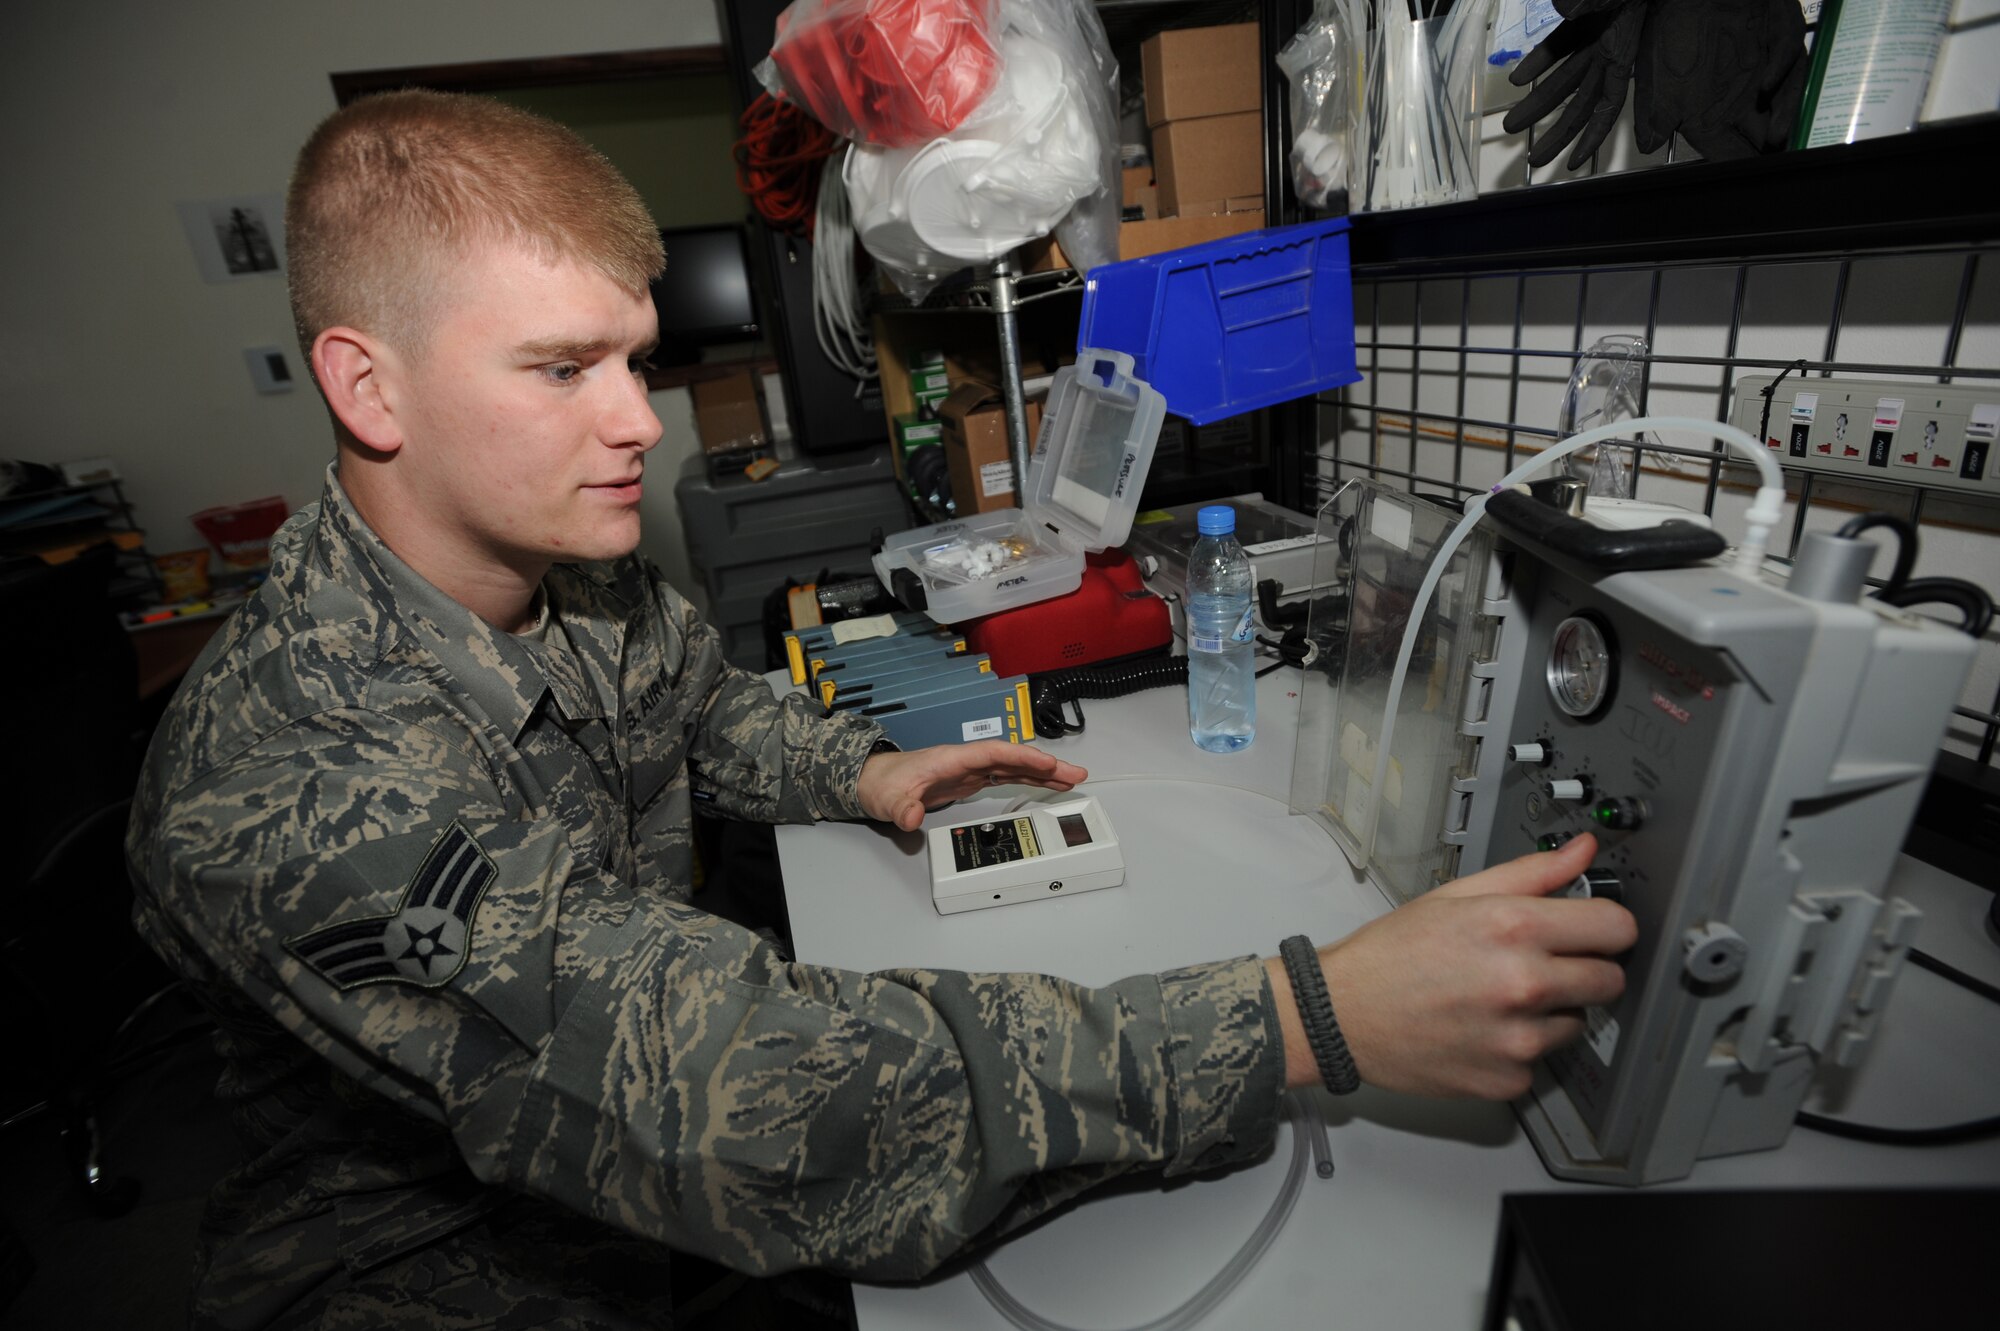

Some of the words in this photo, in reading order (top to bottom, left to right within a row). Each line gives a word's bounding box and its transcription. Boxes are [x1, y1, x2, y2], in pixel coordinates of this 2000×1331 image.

[1875, 439, 1884, 460] 220V
[1969, 450, 1978, 473] 220V
[996, 576, 1029, 590] METER
[640, 681, 664, 718] AIR
